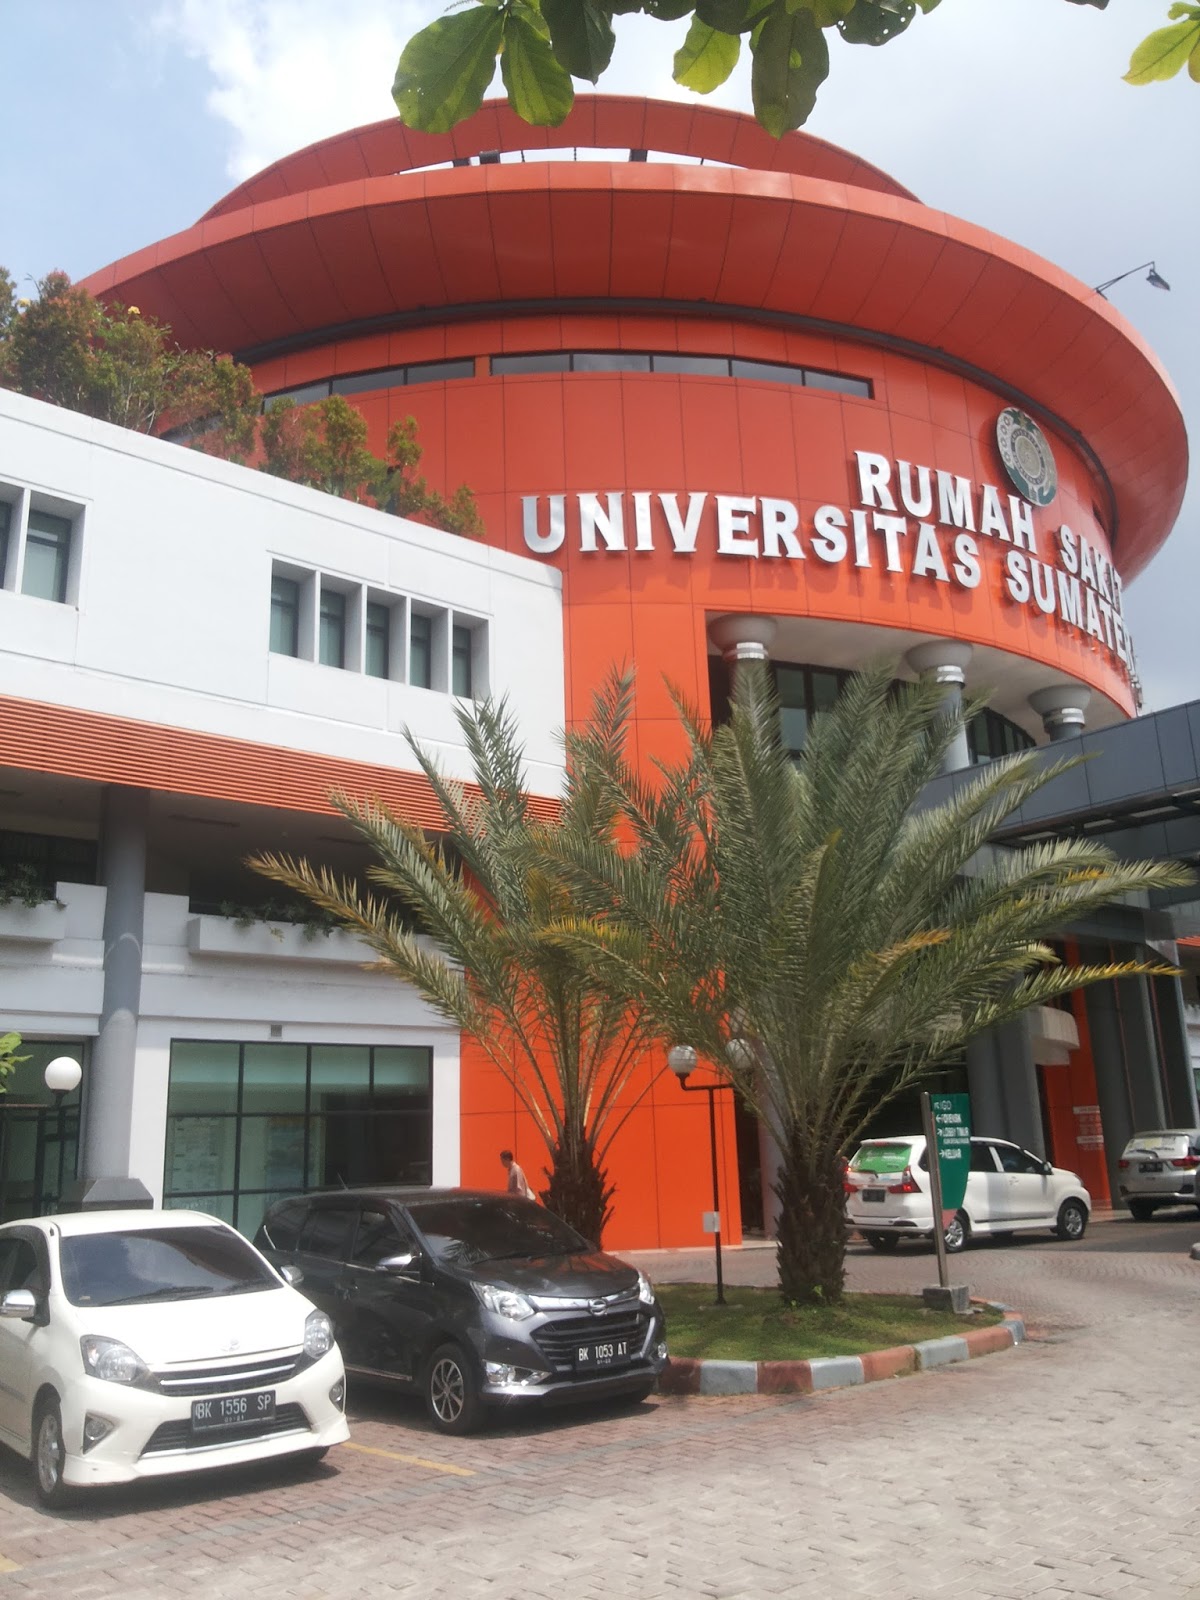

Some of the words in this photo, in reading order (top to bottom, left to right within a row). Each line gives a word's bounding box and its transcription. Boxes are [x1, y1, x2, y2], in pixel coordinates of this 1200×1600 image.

[520, 491, 981, 589] UNIVERSITAS
[854, 450, 1038, 554] RUMAH
[1060, 524, 1124, 618] SAKIT
[579, 1347, 589, 1361] BK
[595, 1344, 614, 1359] 1053
[618, 1342, 627, 1355] AT
[195, 1402, 212, 1419] BK
[220, 1397, 247, 1416] 1556
[257, 1394, 271, 1411] SP
